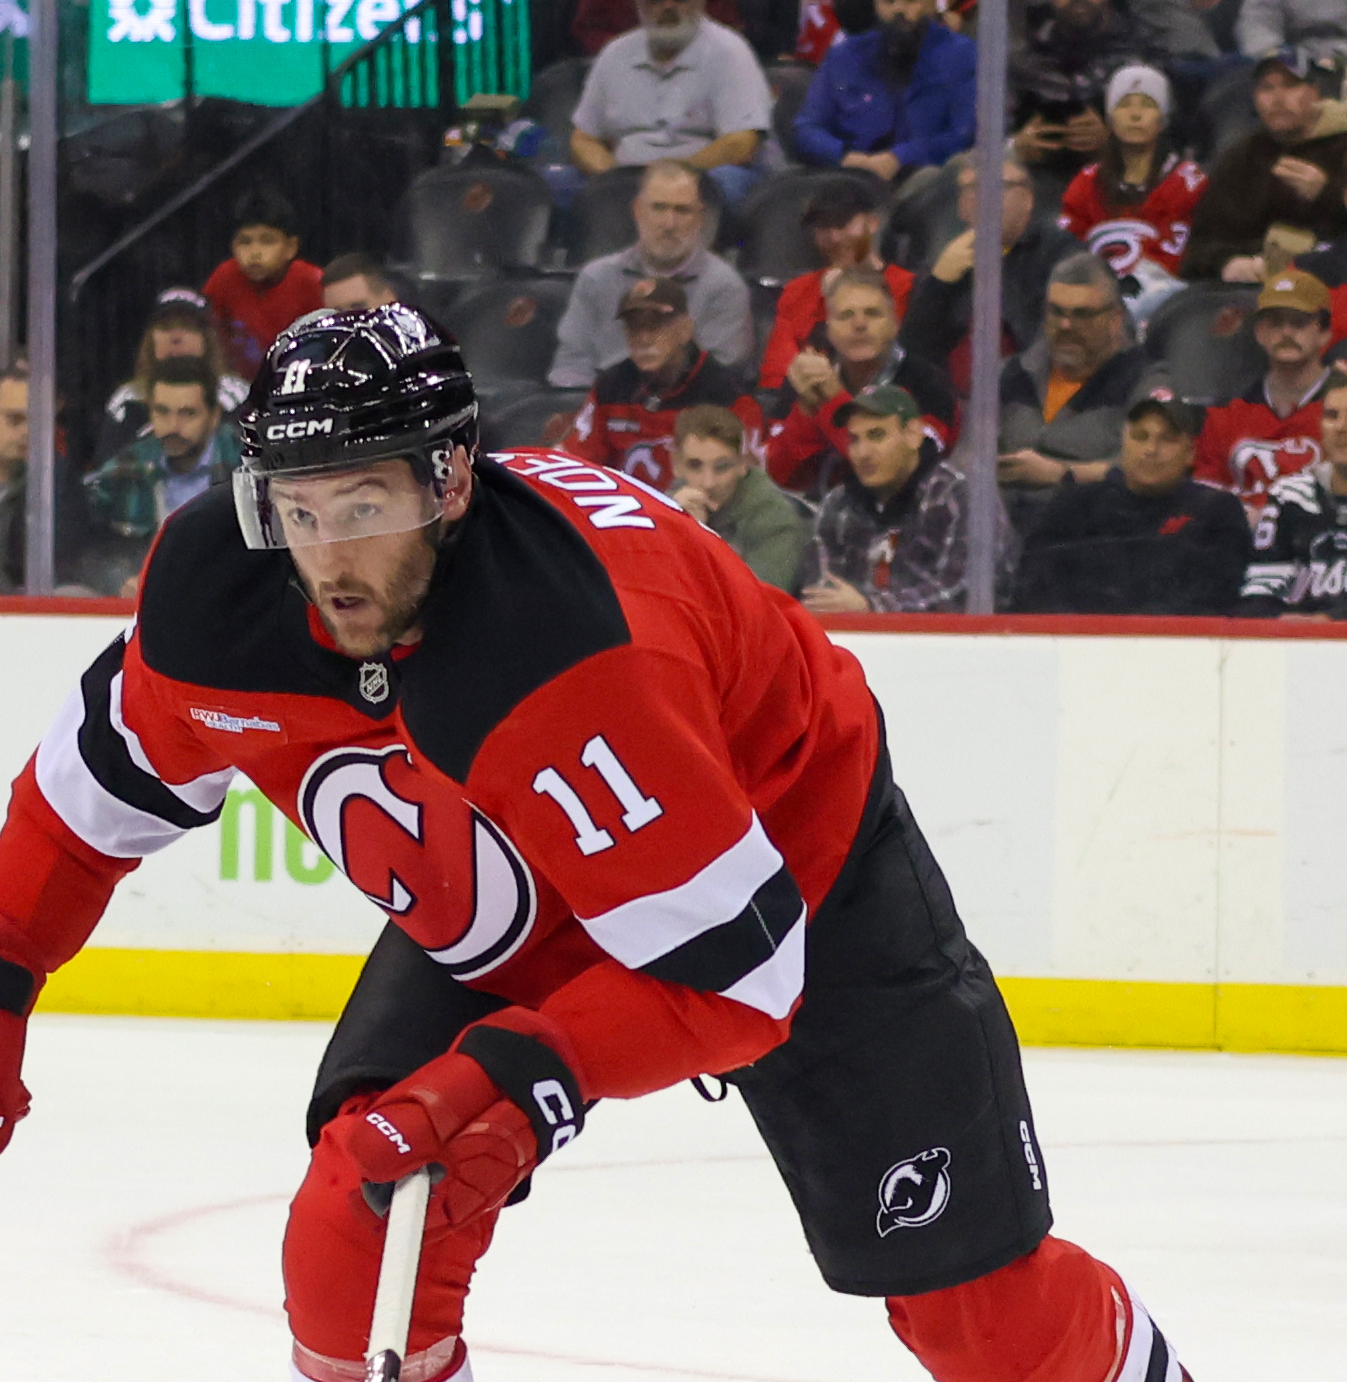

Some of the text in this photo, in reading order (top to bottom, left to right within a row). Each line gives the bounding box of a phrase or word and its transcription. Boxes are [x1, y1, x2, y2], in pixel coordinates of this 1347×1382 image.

[281, 358, 311, 395] 11
[266, 418, 333, 440] CCM
[530, 733, 665, 857] 11
[365, 1112, 411, 1155] CCM
[1019, 1120, 1043, 1190] CCM
